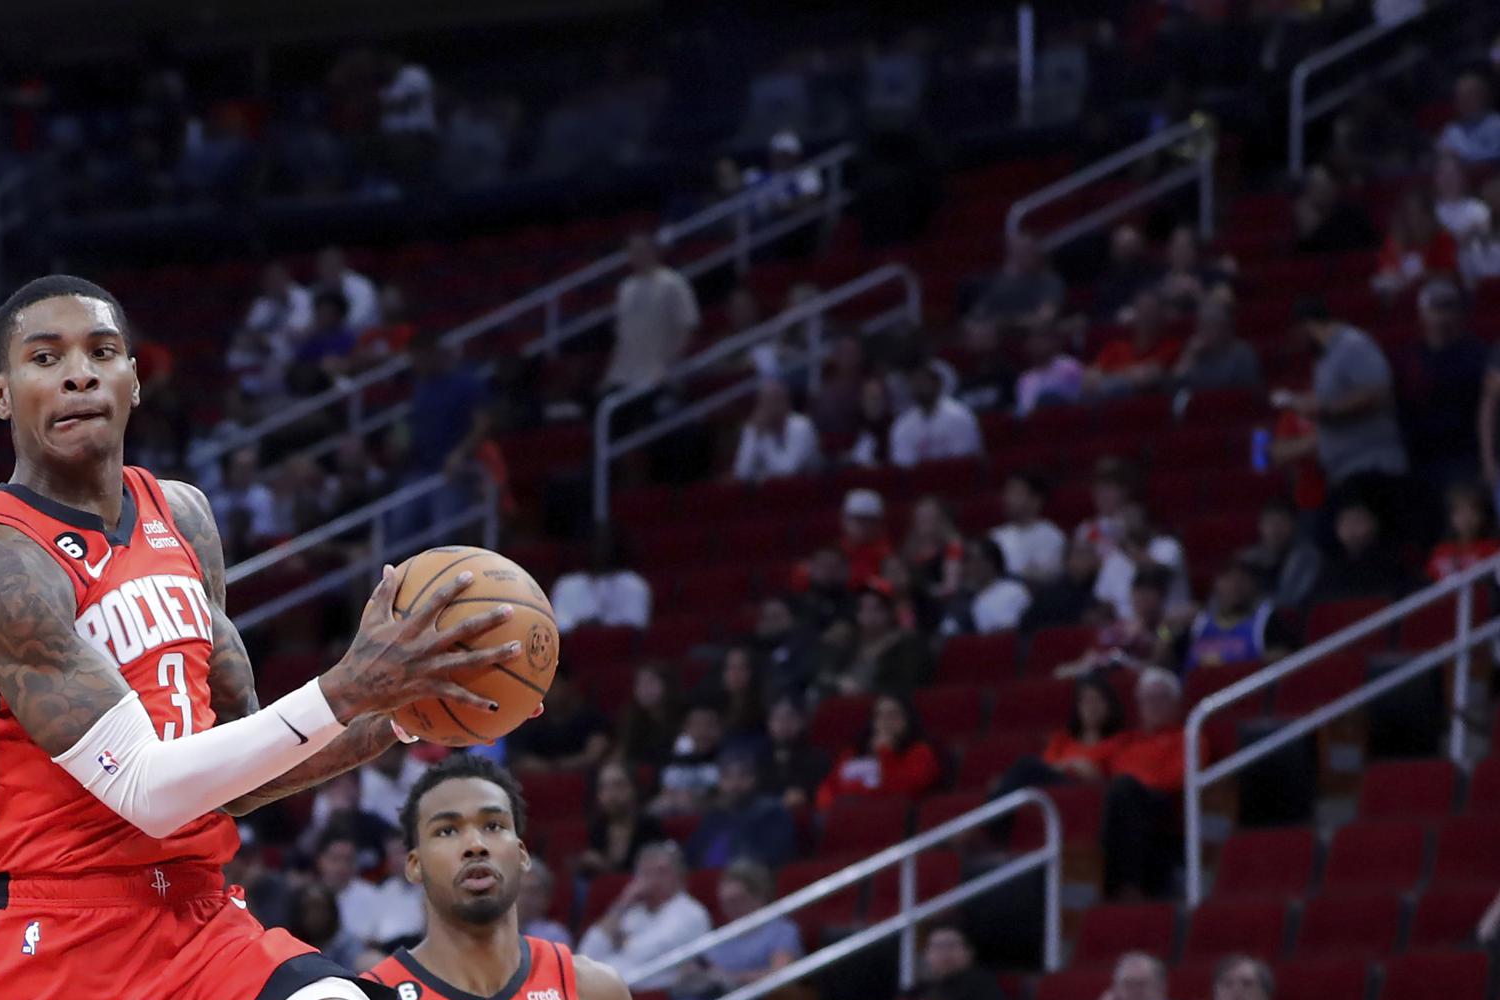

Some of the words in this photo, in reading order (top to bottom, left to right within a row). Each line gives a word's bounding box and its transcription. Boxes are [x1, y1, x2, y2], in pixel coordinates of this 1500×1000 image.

[57, 536, 84, 559] 6
[146, 535, 180, 550] karma
[158, 652, 193, 740] 3
